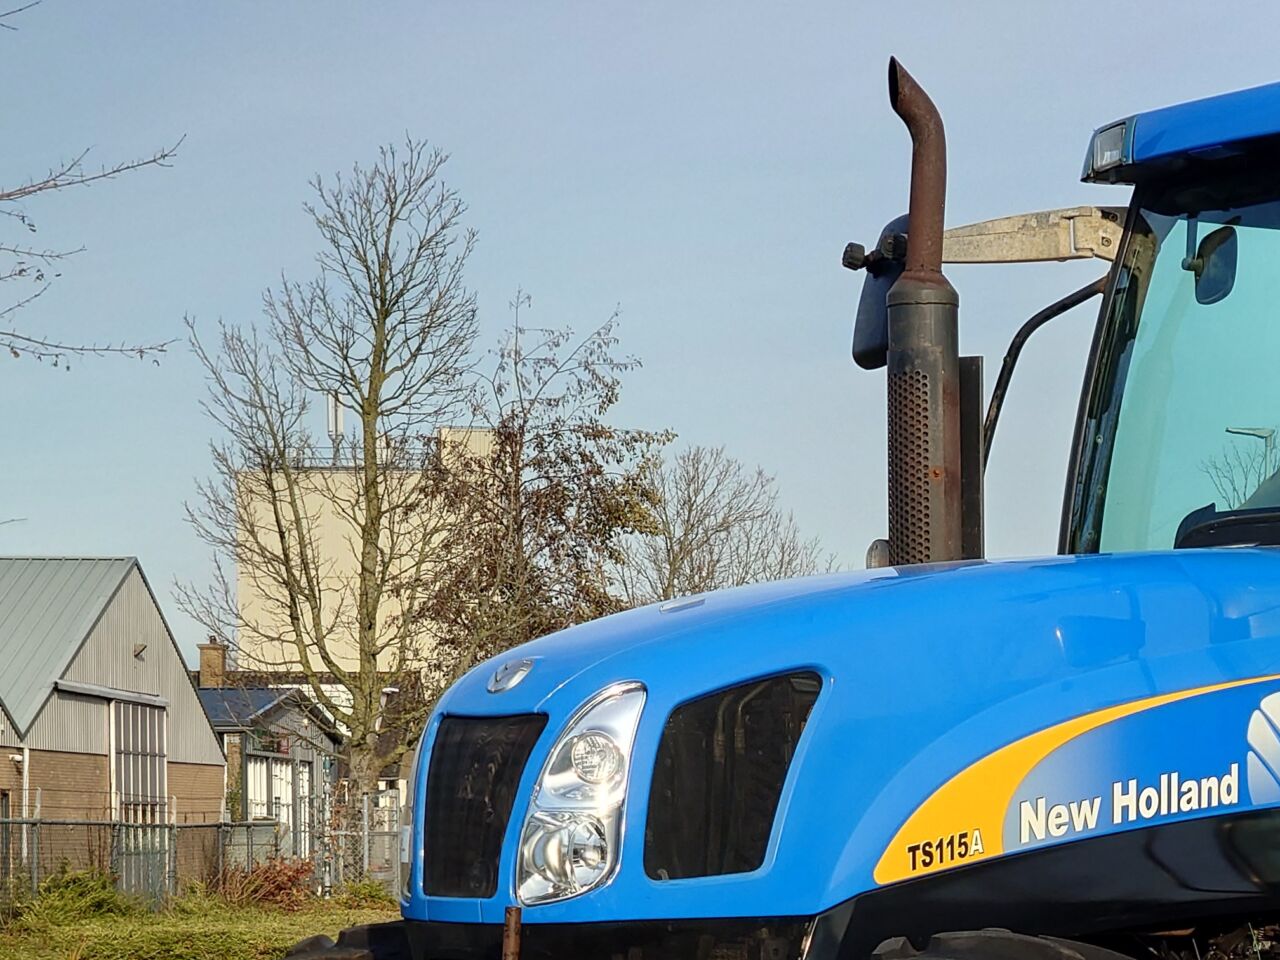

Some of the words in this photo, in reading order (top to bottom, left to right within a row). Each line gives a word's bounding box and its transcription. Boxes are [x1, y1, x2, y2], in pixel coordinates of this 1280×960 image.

[1019, 797, 1102, 844] New
[1112, 763, 1239, 824] Holland
[907, 830, 984, 871] TS115A
